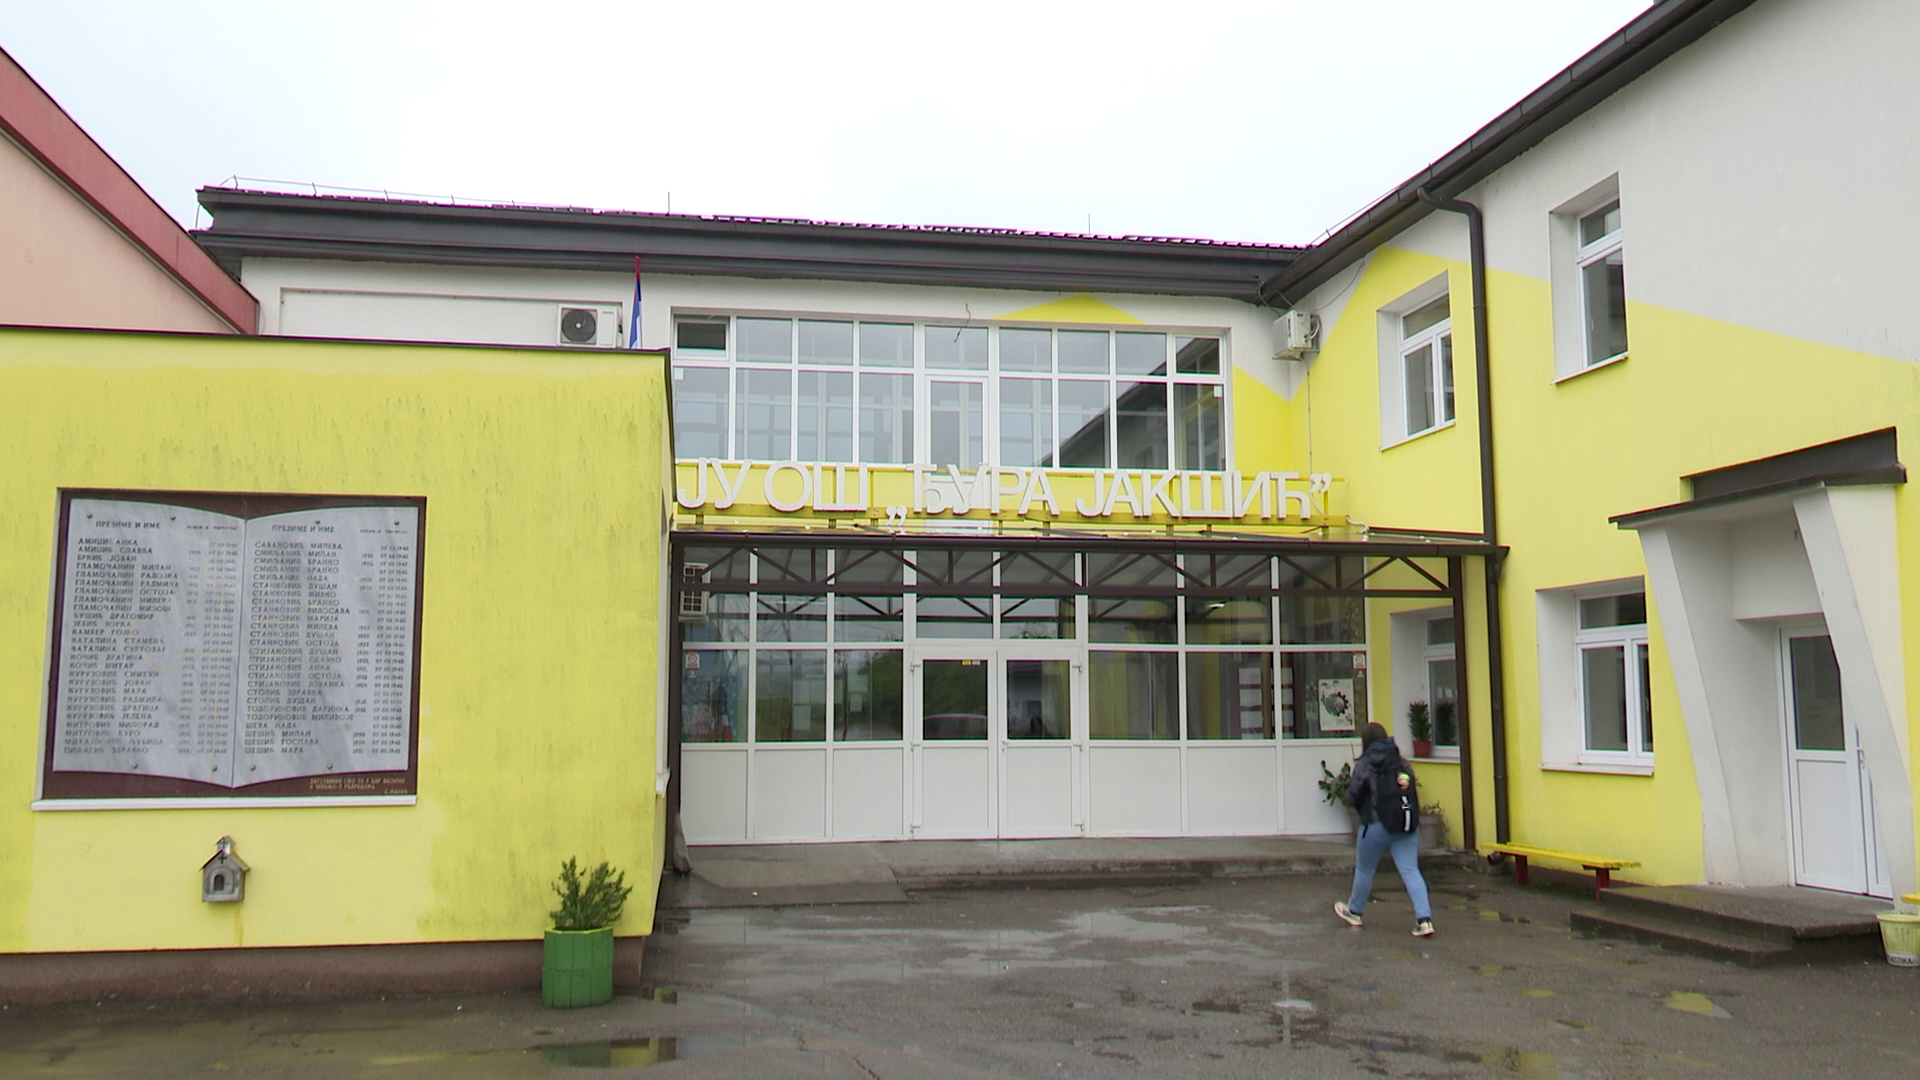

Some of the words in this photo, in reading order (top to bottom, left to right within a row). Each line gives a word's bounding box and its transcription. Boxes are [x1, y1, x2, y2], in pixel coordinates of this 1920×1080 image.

[763, 460, 868, 512] ОШ
[95, 521, 132, 529] ПРЕЗИМЕ
[272, 525, 308, 533] ПРЕЗИМЕ
[317, 525, 335, 533] ИМЕ
